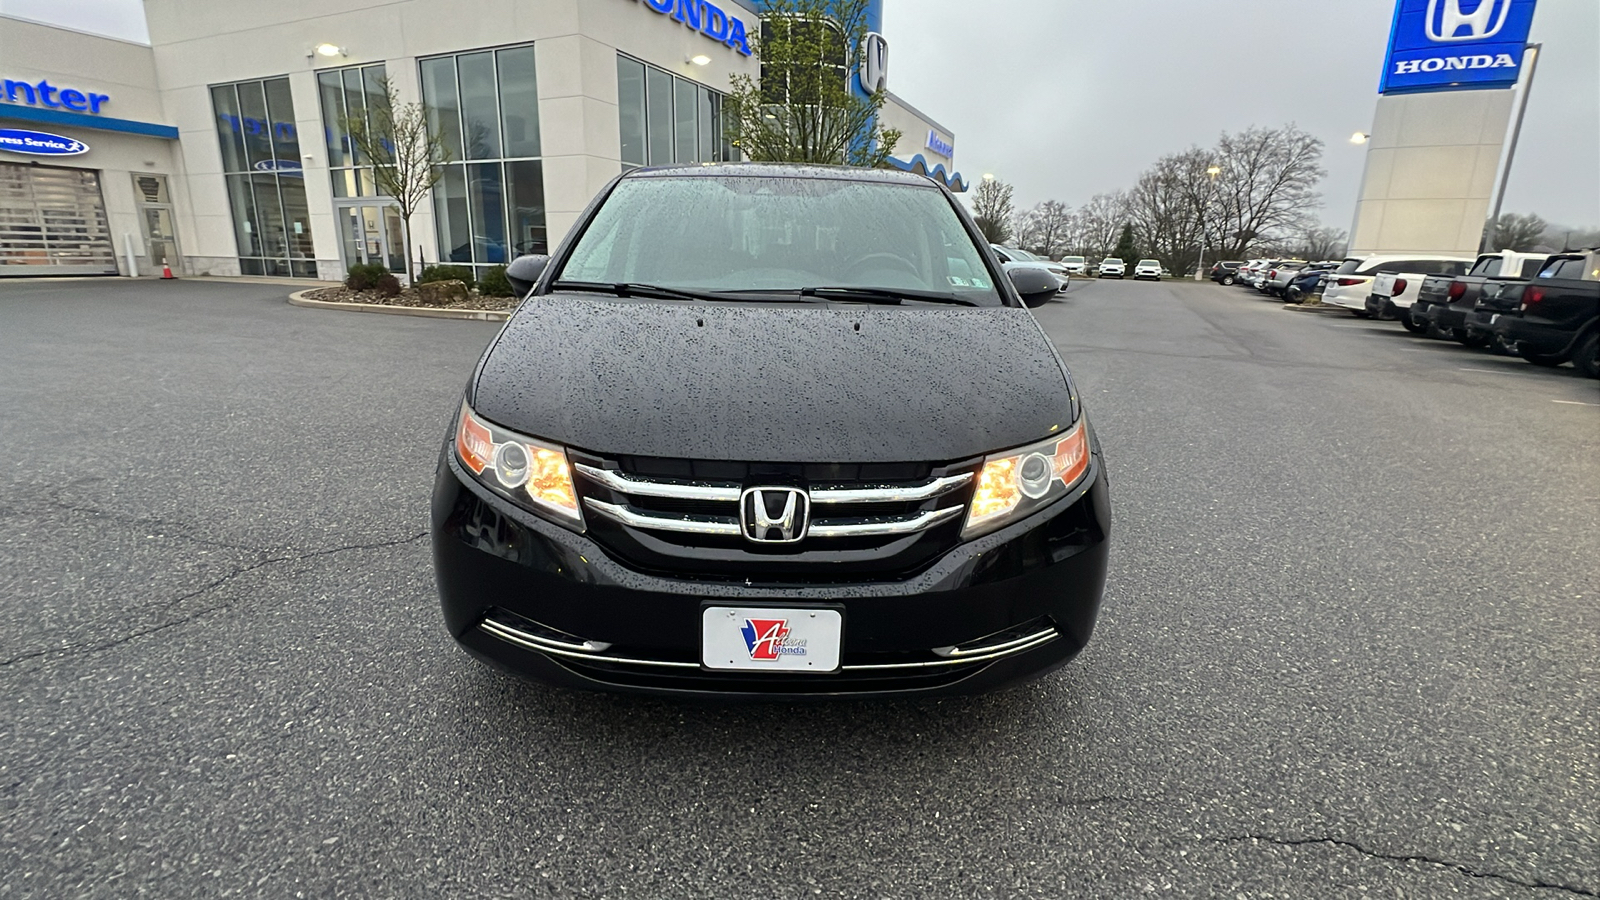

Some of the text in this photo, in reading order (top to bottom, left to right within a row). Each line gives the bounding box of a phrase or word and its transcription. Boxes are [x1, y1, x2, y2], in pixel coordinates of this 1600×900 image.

[1393, 53, 1517, 75] HONDA
[0, 79, 110, 114] nter
[0, 136, 66, 149] ress Service
[773, 645, 806, 655] Honda
